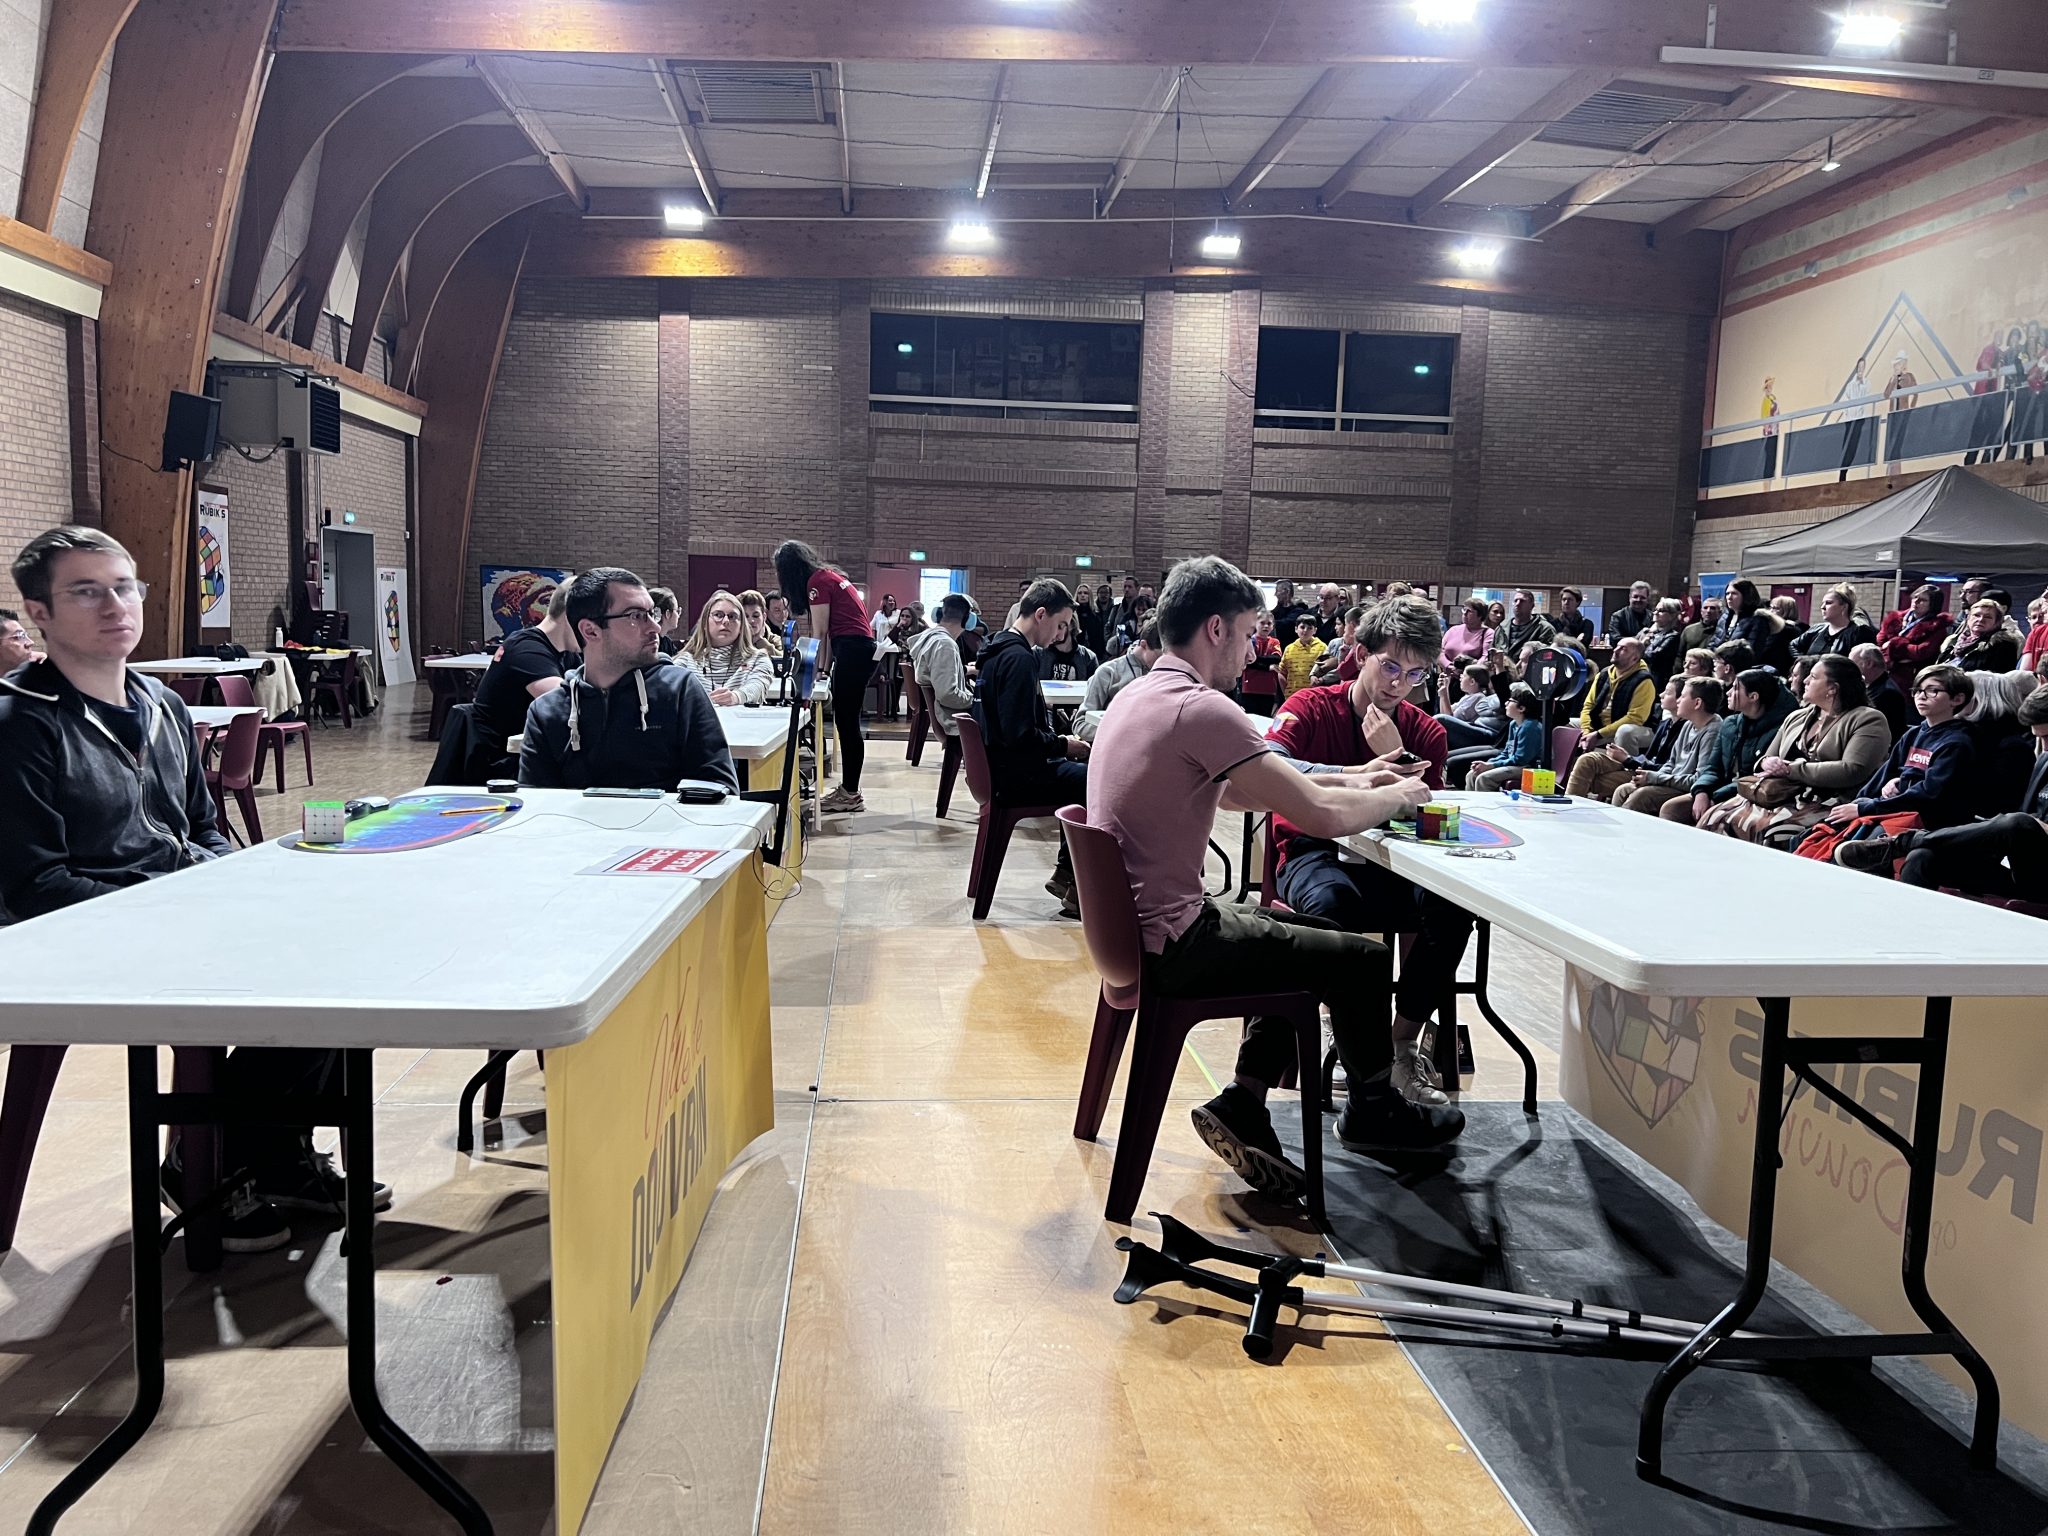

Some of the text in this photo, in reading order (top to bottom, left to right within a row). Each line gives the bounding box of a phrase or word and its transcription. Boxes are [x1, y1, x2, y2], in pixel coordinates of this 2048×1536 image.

[627, 849, 679, 871] SILENCE
[662, 852, 709, 871] PLEASE
[630, 1056, 707, 1312] DOUVRIN
